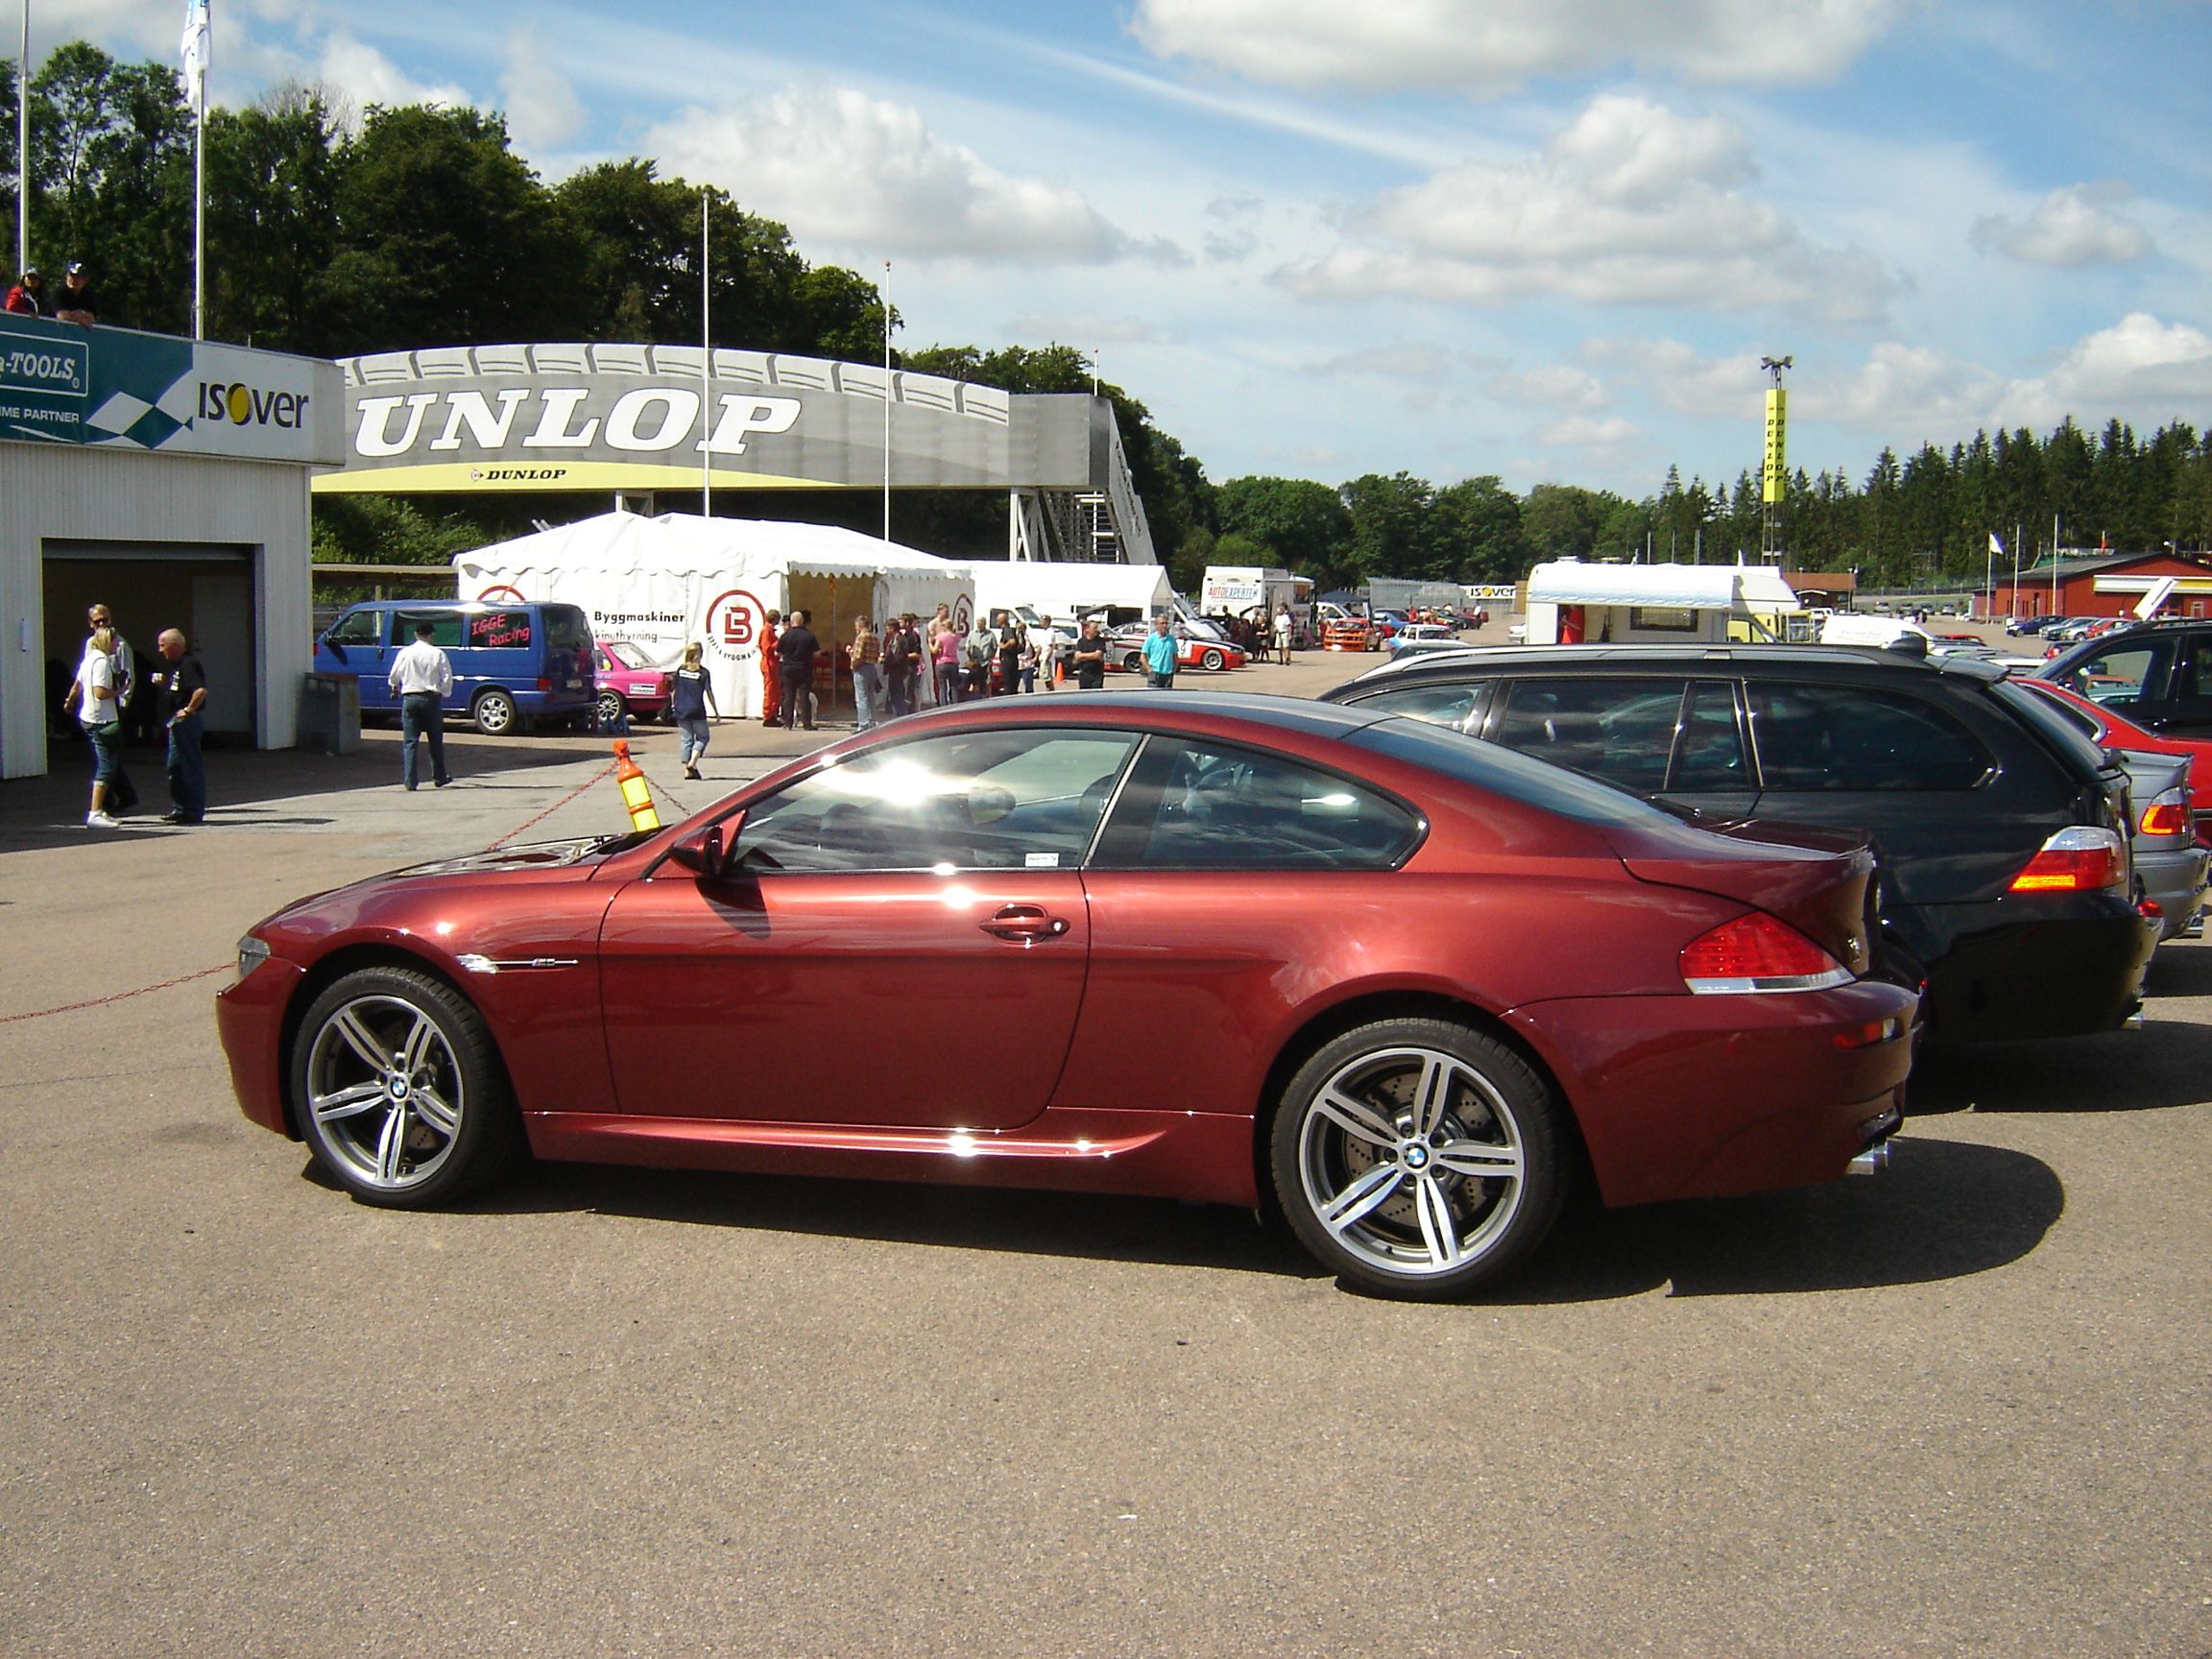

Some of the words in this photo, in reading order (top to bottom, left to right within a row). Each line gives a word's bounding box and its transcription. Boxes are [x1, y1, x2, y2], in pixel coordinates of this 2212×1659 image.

[23, 408, 80, 423] PARTNER
[1767, 419, 1775, 482] DUNLOP
[1775, 419, 1785, 483] DUNLOP
[486, 469, 566, 480] DUNLOP
[471, 613, 507, 636] IGGE
[594, 611, 685, 624] Byggmaskiner
[489, 627, 530, 646] Racing
